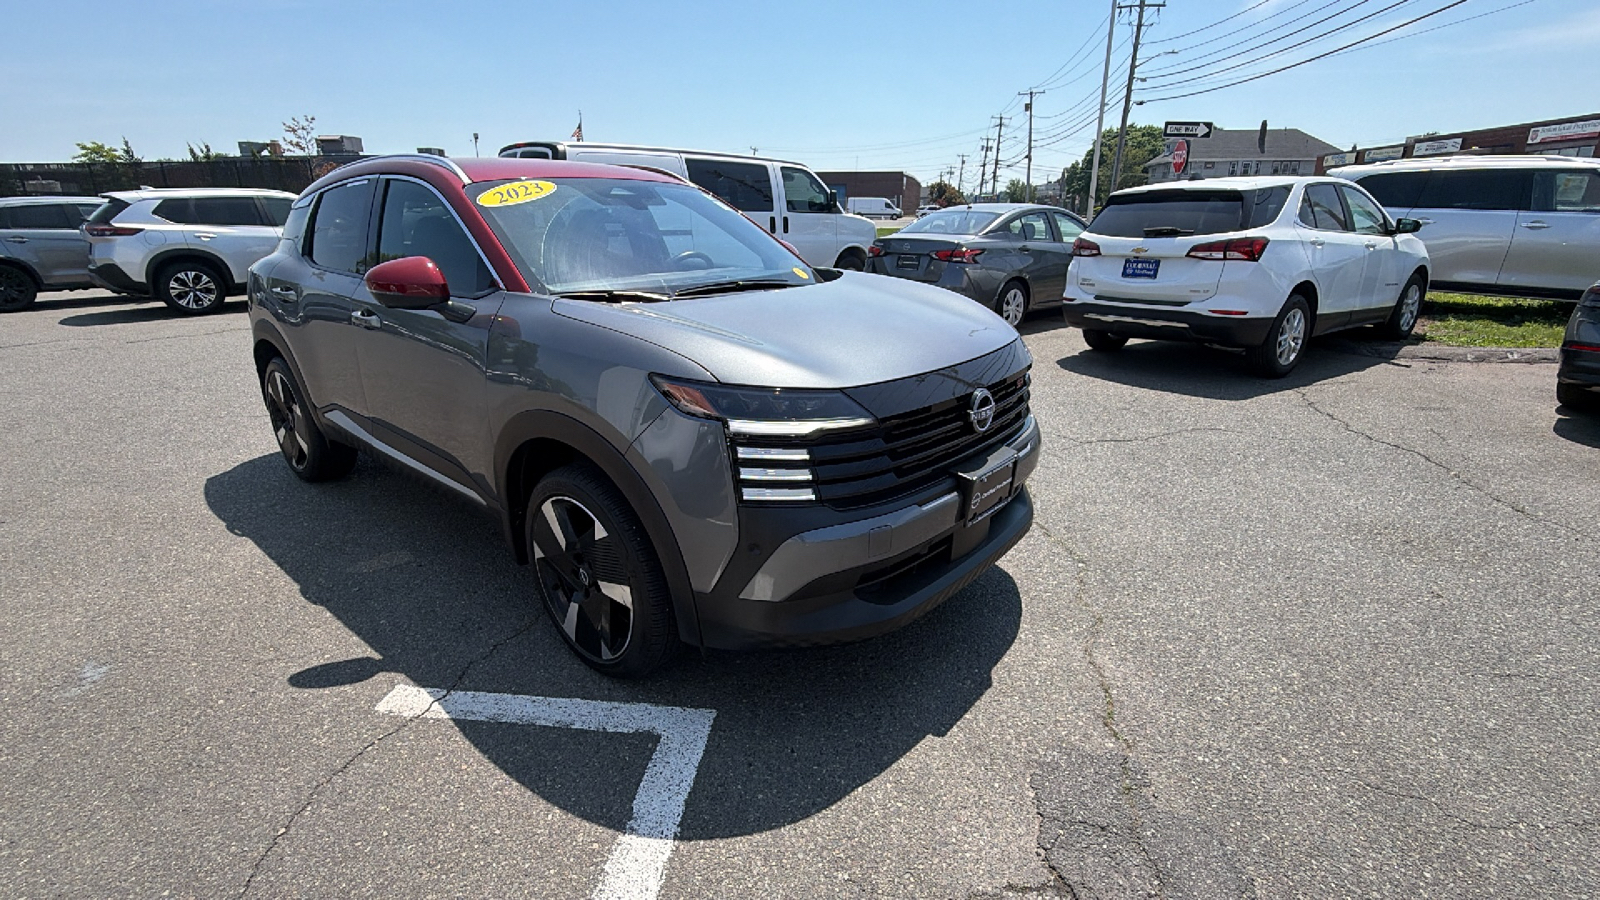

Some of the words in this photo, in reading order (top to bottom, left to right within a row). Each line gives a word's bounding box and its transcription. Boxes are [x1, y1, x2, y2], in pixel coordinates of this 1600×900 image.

[1173, 150, 1187, 164] STOP
[492, 182, 544, 204] 2023
[1126, 262, 1157, 270] COLONIAL
